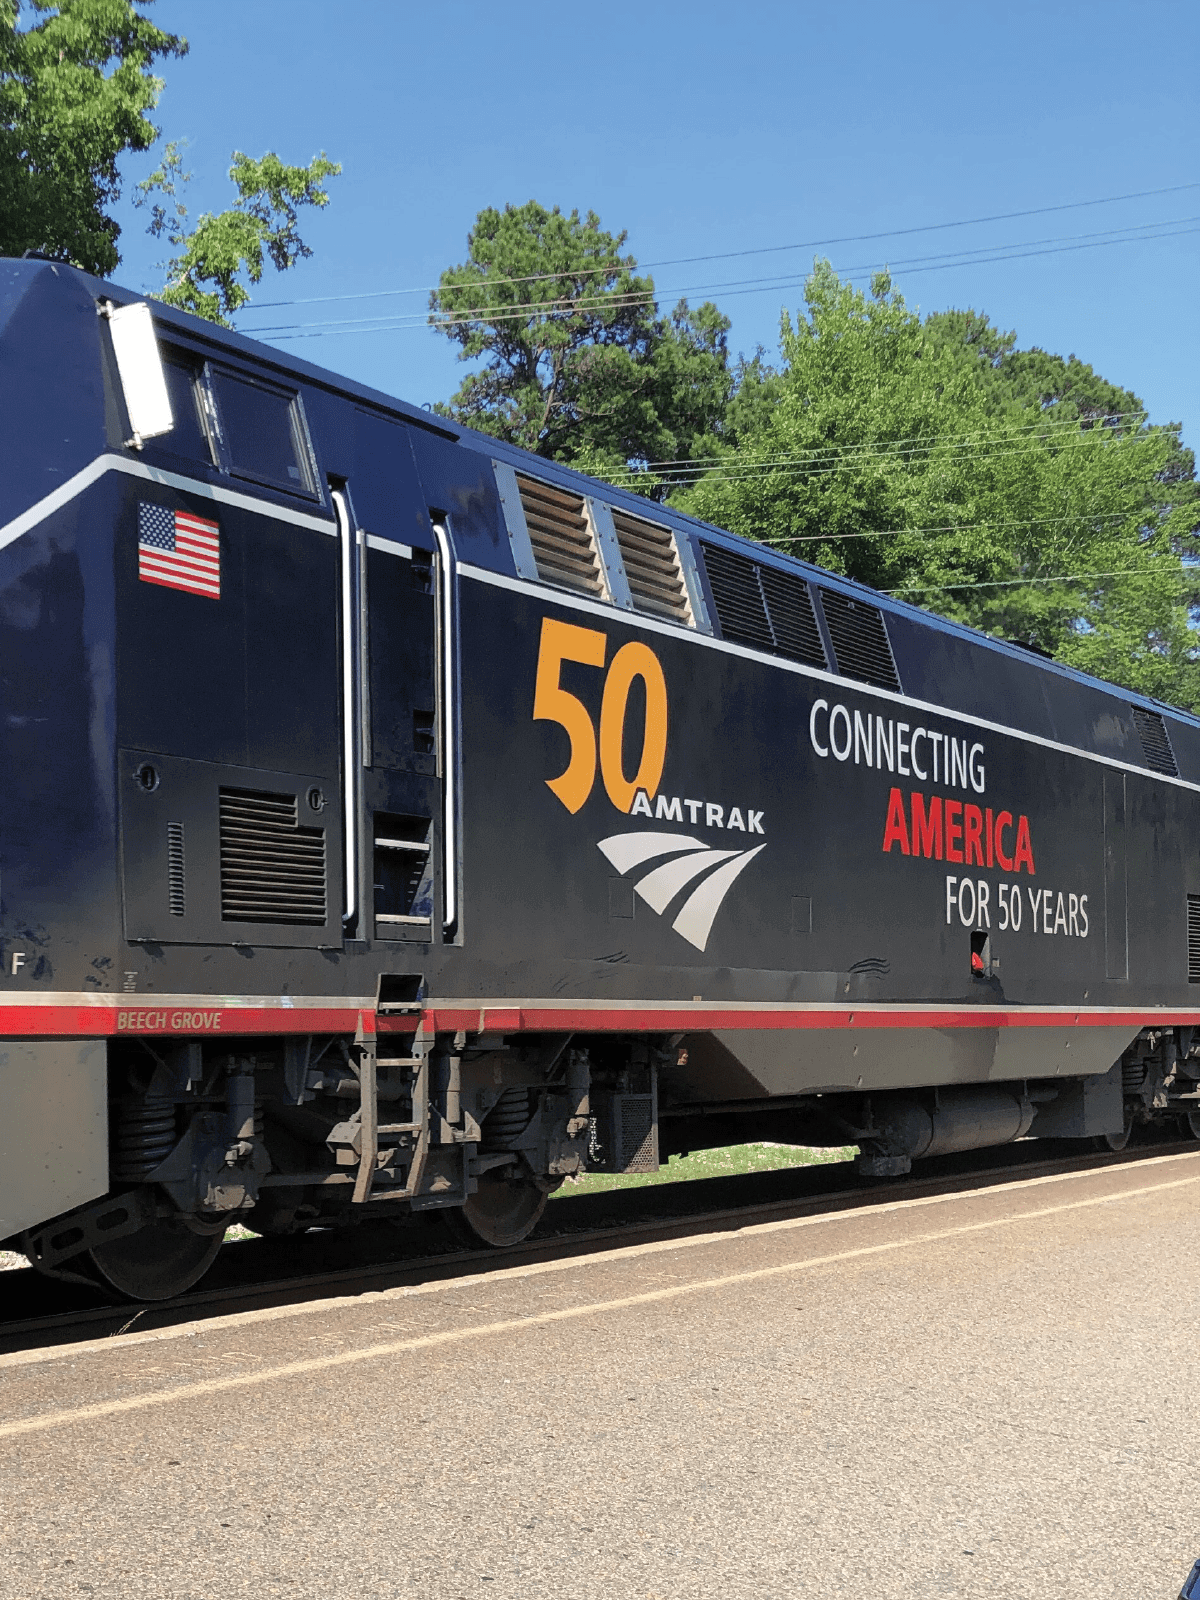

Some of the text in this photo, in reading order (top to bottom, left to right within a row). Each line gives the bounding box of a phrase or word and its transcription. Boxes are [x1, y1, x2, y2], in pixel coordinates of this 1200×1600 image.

[532, 616, 668, 815] 50
[809, 698, 986, 794] CONNECTING
[630, 791, 766, 835] AMTRAK
[882, 787, 1036, 875] AMERICA
[946, 875, 1090, 938] FOR 50 YEARS
[11, 952, 26, 975] F
[117, 1011, 222, 1030] BEECH GROVE
